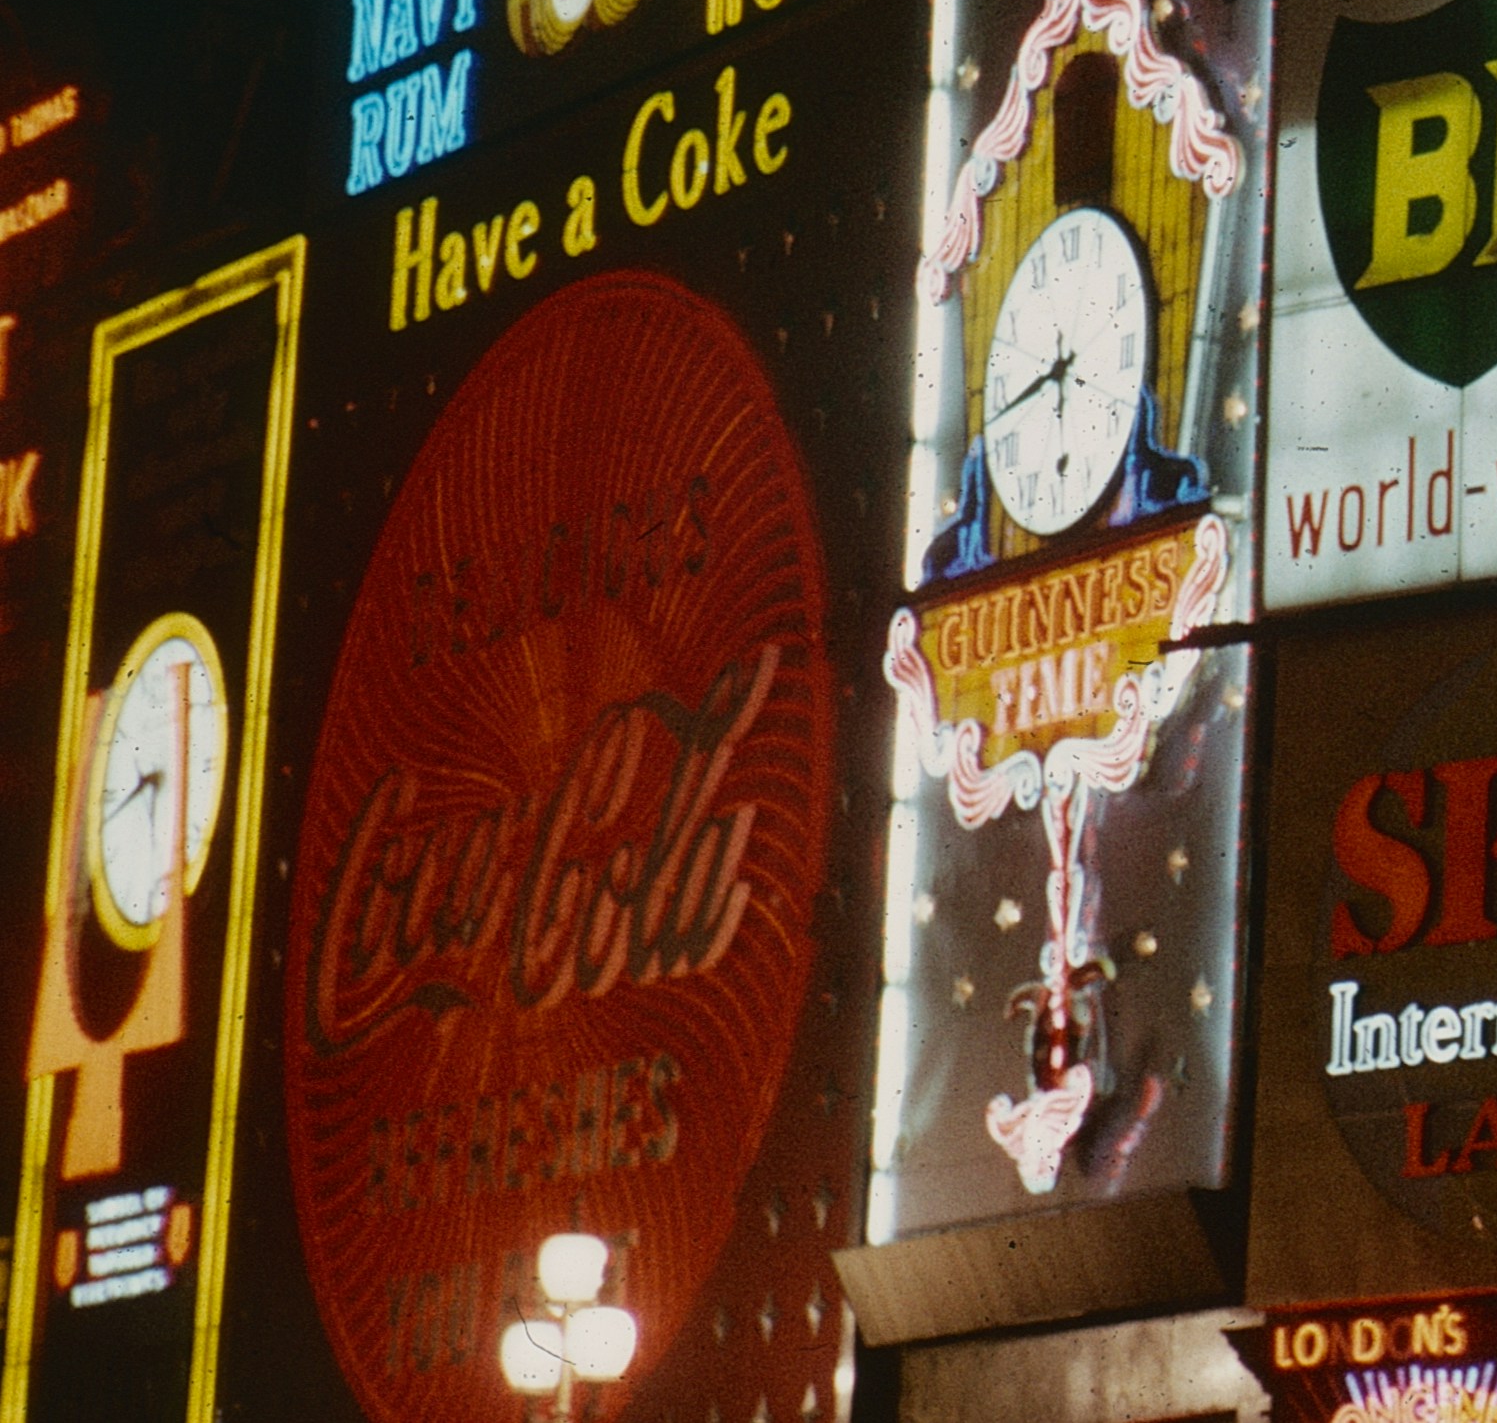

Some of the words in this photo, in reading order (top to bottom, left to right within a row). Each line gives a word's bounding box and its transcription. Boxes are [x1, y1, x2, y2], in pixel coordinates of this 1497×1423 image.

[346, 48, 474, 198] RUM
[388, 196, 542, 333] Have
[560, 175, 599, 258] a
[621, 64, 794, 228] Coke
[936, 541, 1181, 675] GUINNESS
[990, 640, 1112, 735] TIME
[368, 1051, 683, 1213] REFRESHES
[1274, 1302, 1468, 1371] LONDON'S
